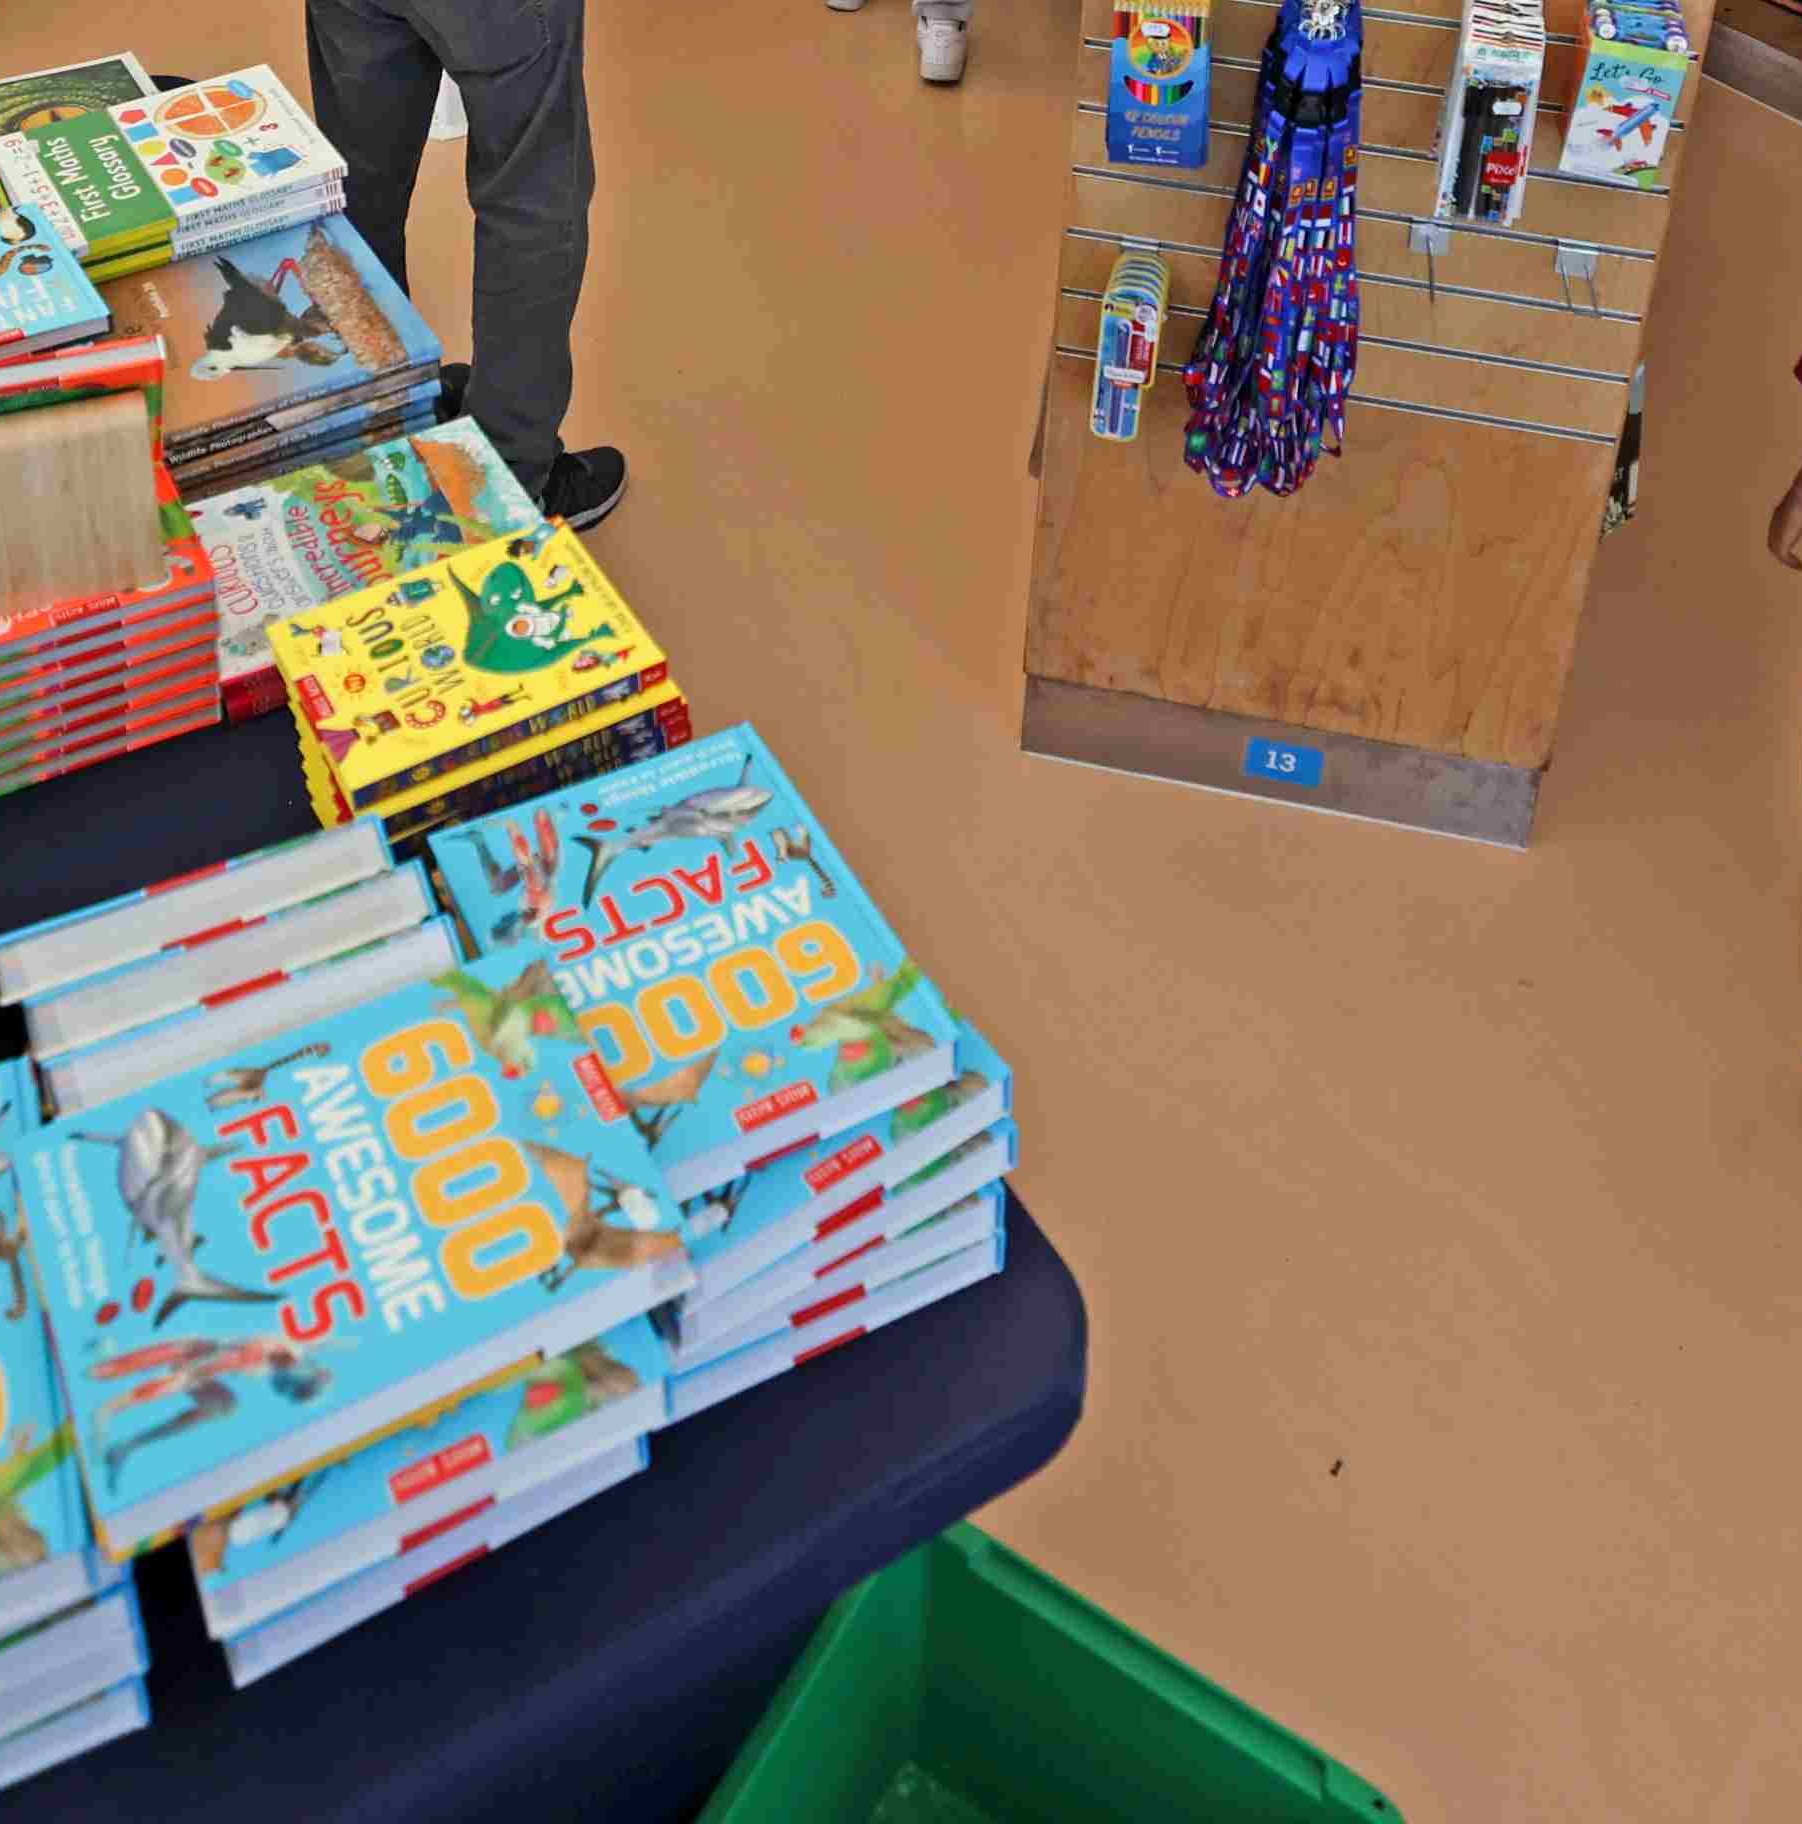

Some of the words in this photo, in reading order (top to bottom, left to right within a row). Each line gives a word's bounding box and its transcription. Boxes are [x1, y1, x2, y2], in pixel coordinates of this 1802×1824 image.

[1589, 61, 1631, 85] Let's
[1638, 66, 1664, 85] Go
[46, 136, 87, 188] Maths
[75, 181, 111, 224] First
[88, 133, 142, 201] Glossary
[185, 207, 212, 223] FIRST
[213, 198, 247, 215] MATHS
[168, 446, 207, 466] Wildlife
[344, 605, 448, 730] CURIOUS
[1264, 749, 1297, 775] 13
[542, 838, 775, 963] FACTS
[553, 875, 812, 1010] AWESOME
[575, 920, 861, 1088] 6000
[293, 1063, 448, 1334] AWESOME
[358, 1016, 564, 1303] 6000
[216, 1104, 367, 1344] FACTS
